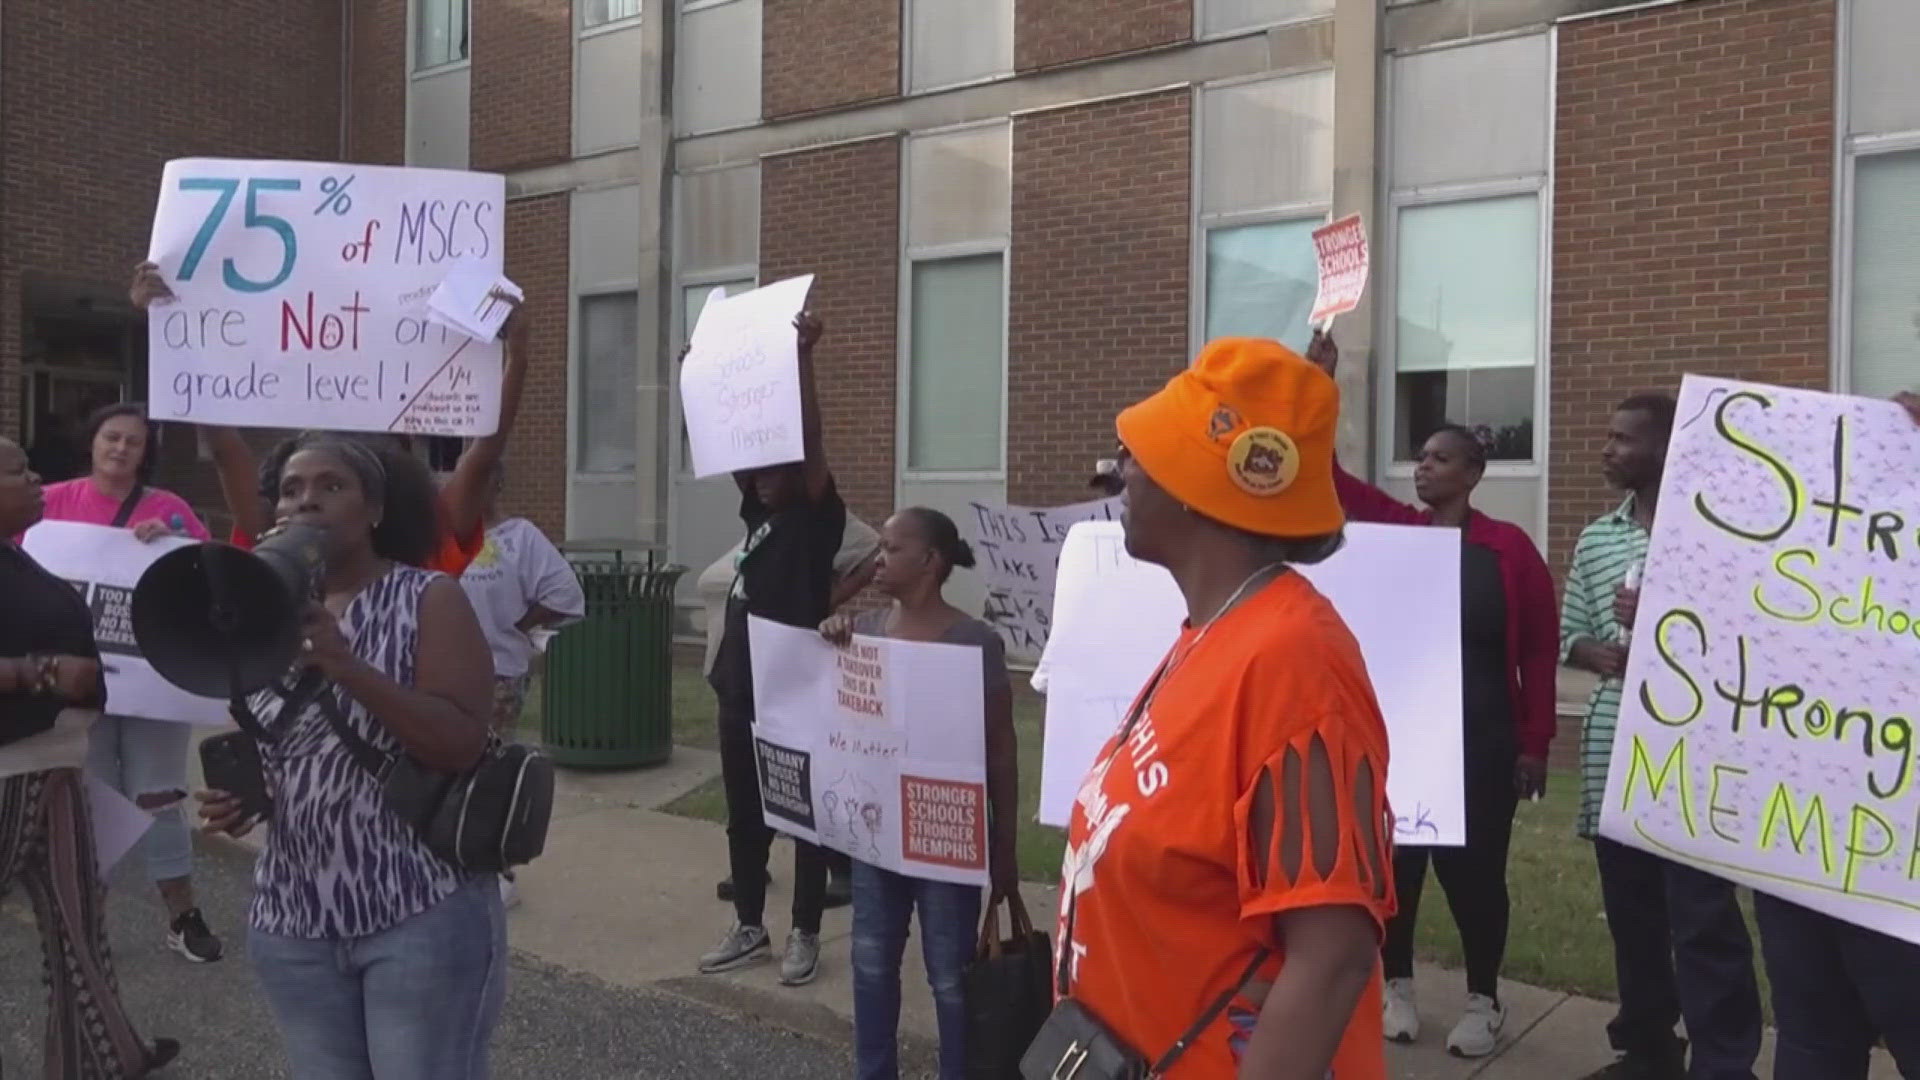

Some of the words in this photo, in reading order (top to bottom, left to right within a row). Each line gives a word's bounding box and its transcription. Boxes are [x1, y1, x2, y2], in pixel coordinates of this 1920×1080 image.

[342, 219, 381, 264] of
[395, 199, 493, 266] MSCS
[164, 307, 247, 349] are
[280, 290, 371, 352] Not
[173, 362, 280, 416] grade
[969, 502, 1026, 543] THIS
[100, 588, 124, 603] TOO
[100, 616, 118, 630] NO
[837, 687, 884, 718] TAKEBACK
[829, 731, 847, 752] We
[906, 781, 977, 807] STRONGER
[908, 800, 976, 826] SCHOOLS
[908, 819, 975, 843] STRONGER
[909, 835, 978, 862] MEMPHIS
